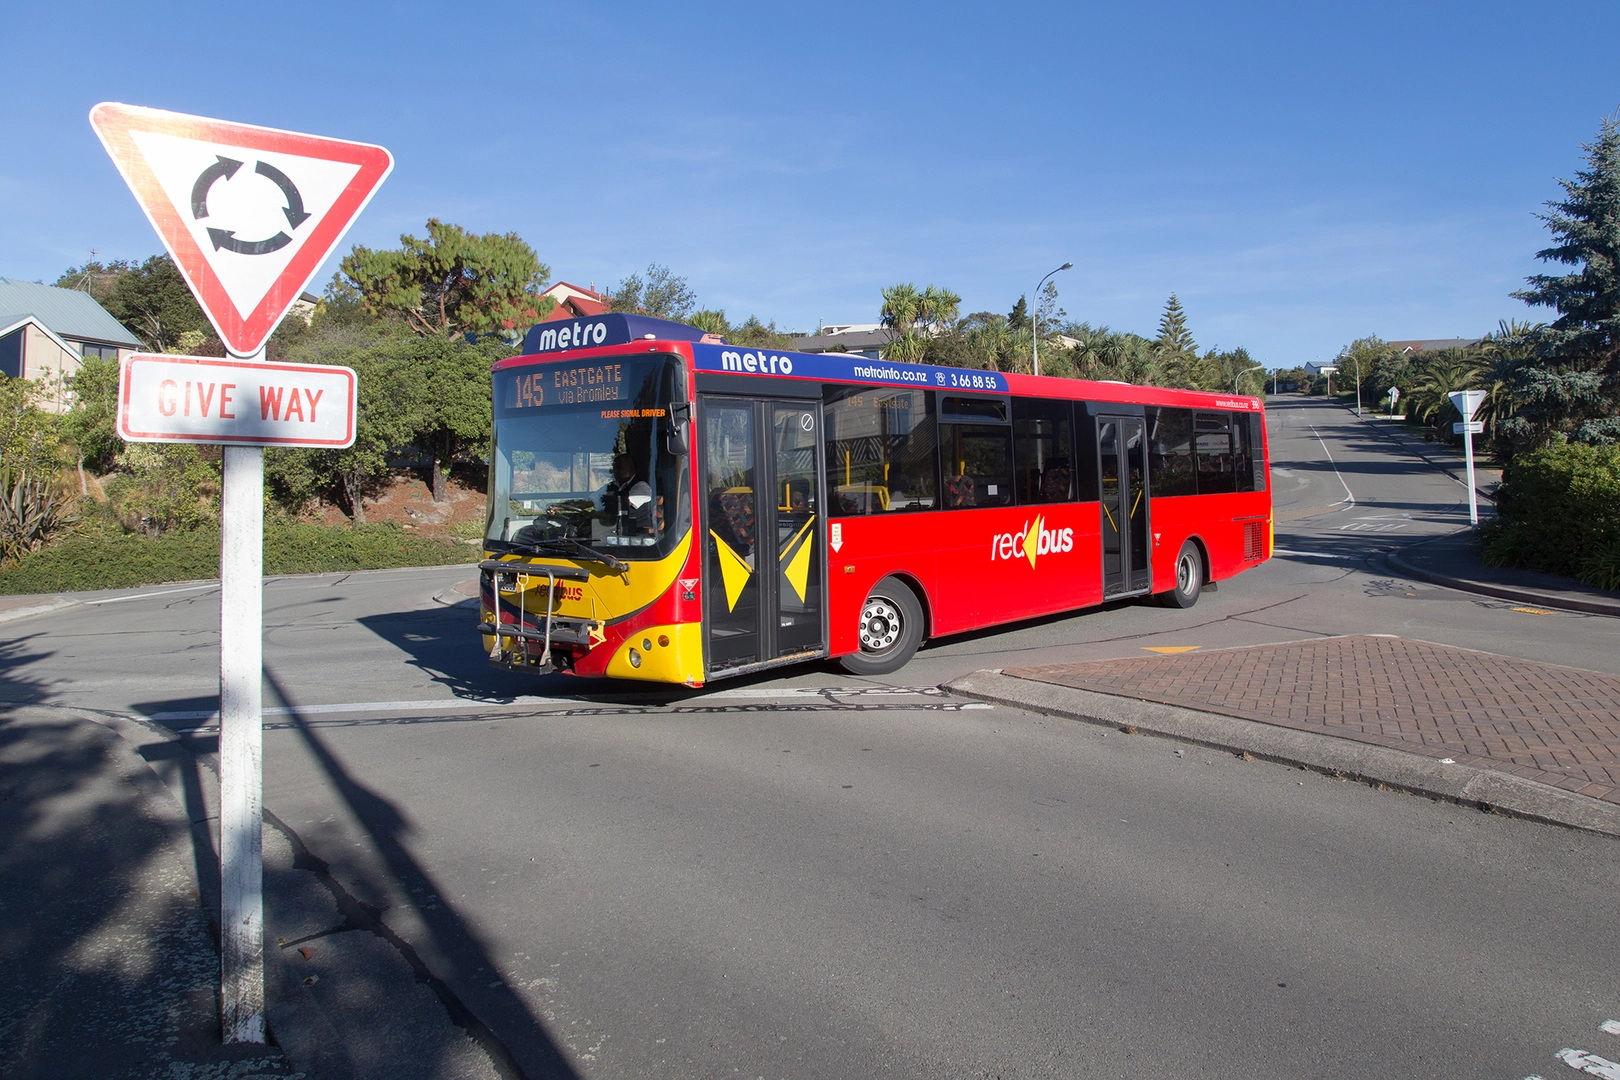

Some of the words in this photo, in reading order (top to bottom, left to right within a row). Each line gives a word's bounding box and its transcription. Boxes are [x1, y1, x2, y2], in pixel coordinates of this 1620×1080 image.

[539, 322, 607, 351] metro
[721, 350, 793, 375] metro
[853, 365, 927, 383] metroinfo.co.nz
[554, 364, 621, 388] EASTGATE
[951, 373, 957, 387] 3
[960, 374, 971, 389] 66
[973, 375, 984, 390] 88
[986, 376, 997, 390] 55
[158, 379, 237, 419] GIVE
[259, 385, 324, 423] WAY
[515, 373, 544, 409] 145
[558, 389, 574, 405] via
[577, 383, 619, 403] Bromley
[847, 396, 864, 408] 145
[601, 409, 621, 418] PLEASE
[621, 409, 641, 418] SIGNAL
[641, 408, 666, 418] DRIVER
